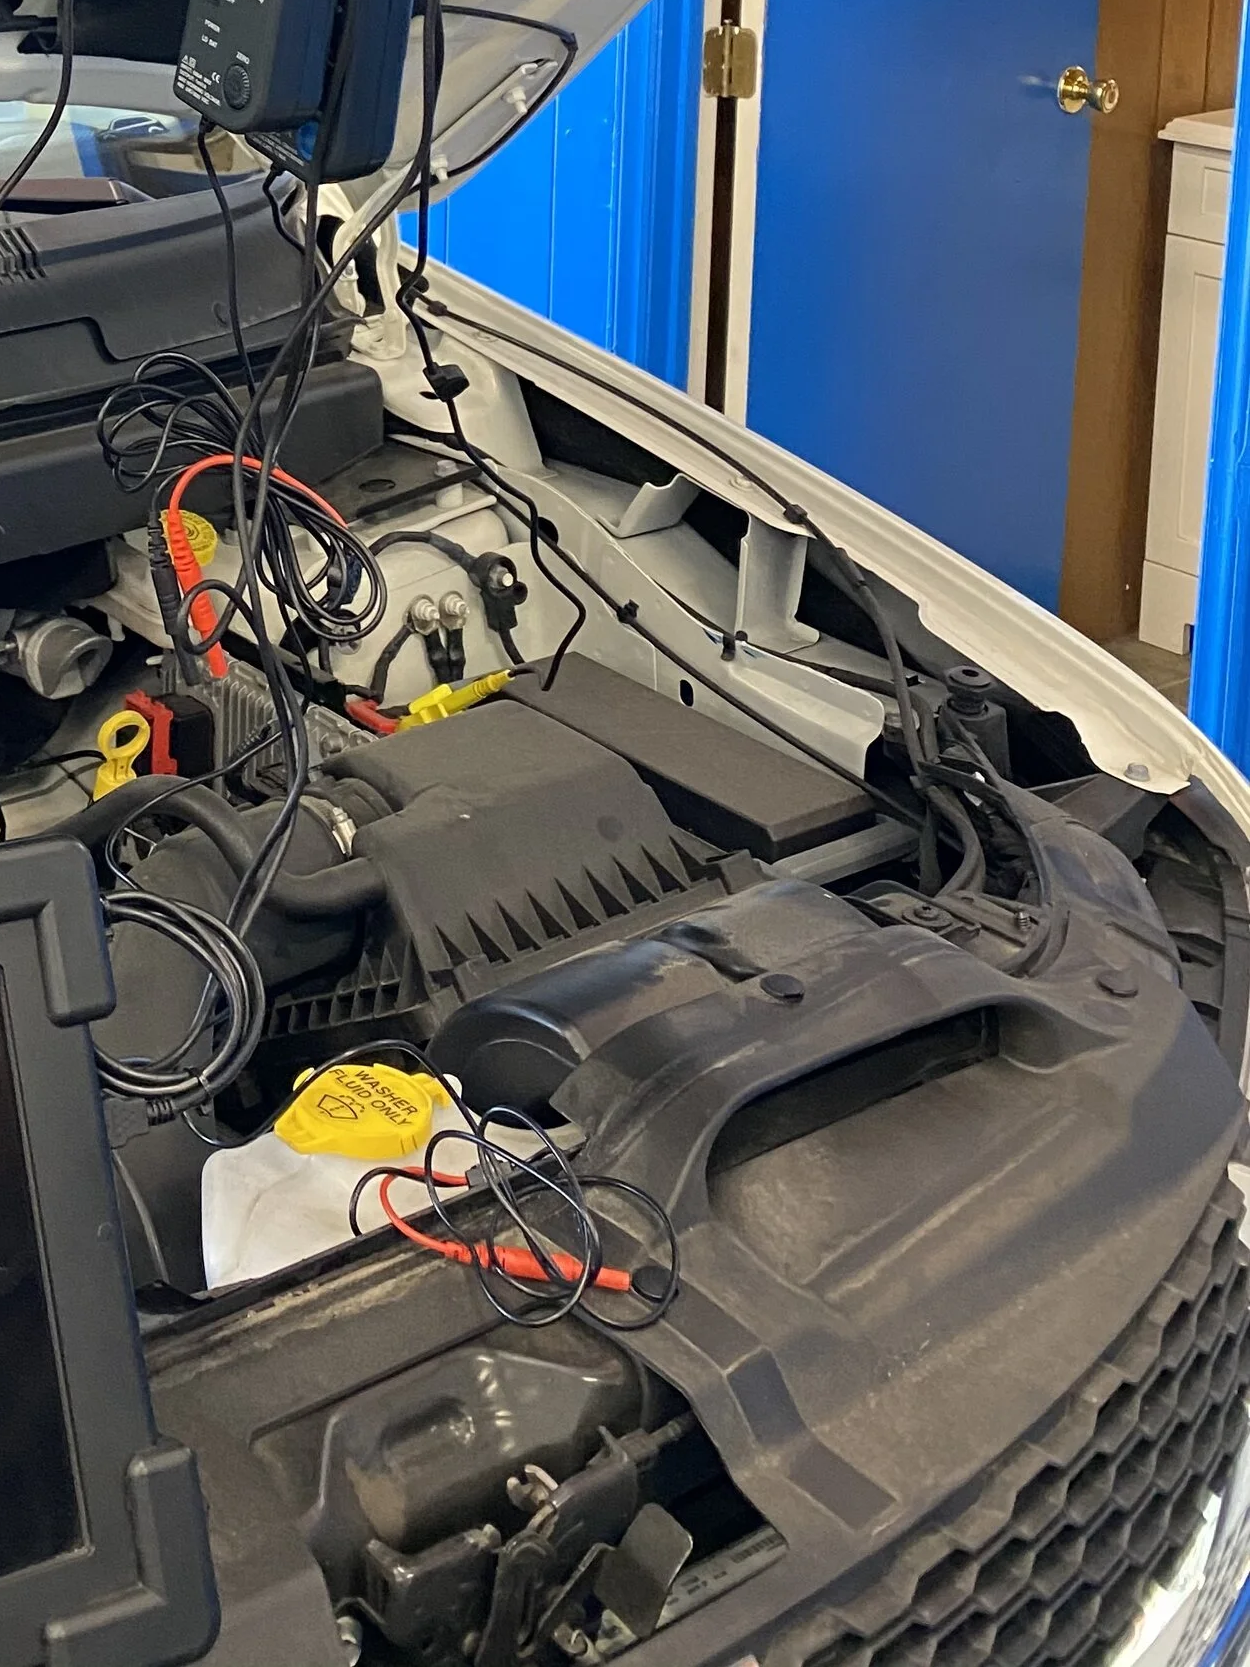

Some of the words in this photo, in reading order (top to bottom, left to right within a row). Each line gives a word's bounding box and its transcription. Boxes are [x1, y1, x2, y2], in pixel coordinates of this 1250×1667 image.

[329, 1068, 372, 1099] FLUID
[371, 1099, 412, 1126] ONLY
[355, 1070, 418, 1116] WASHER
